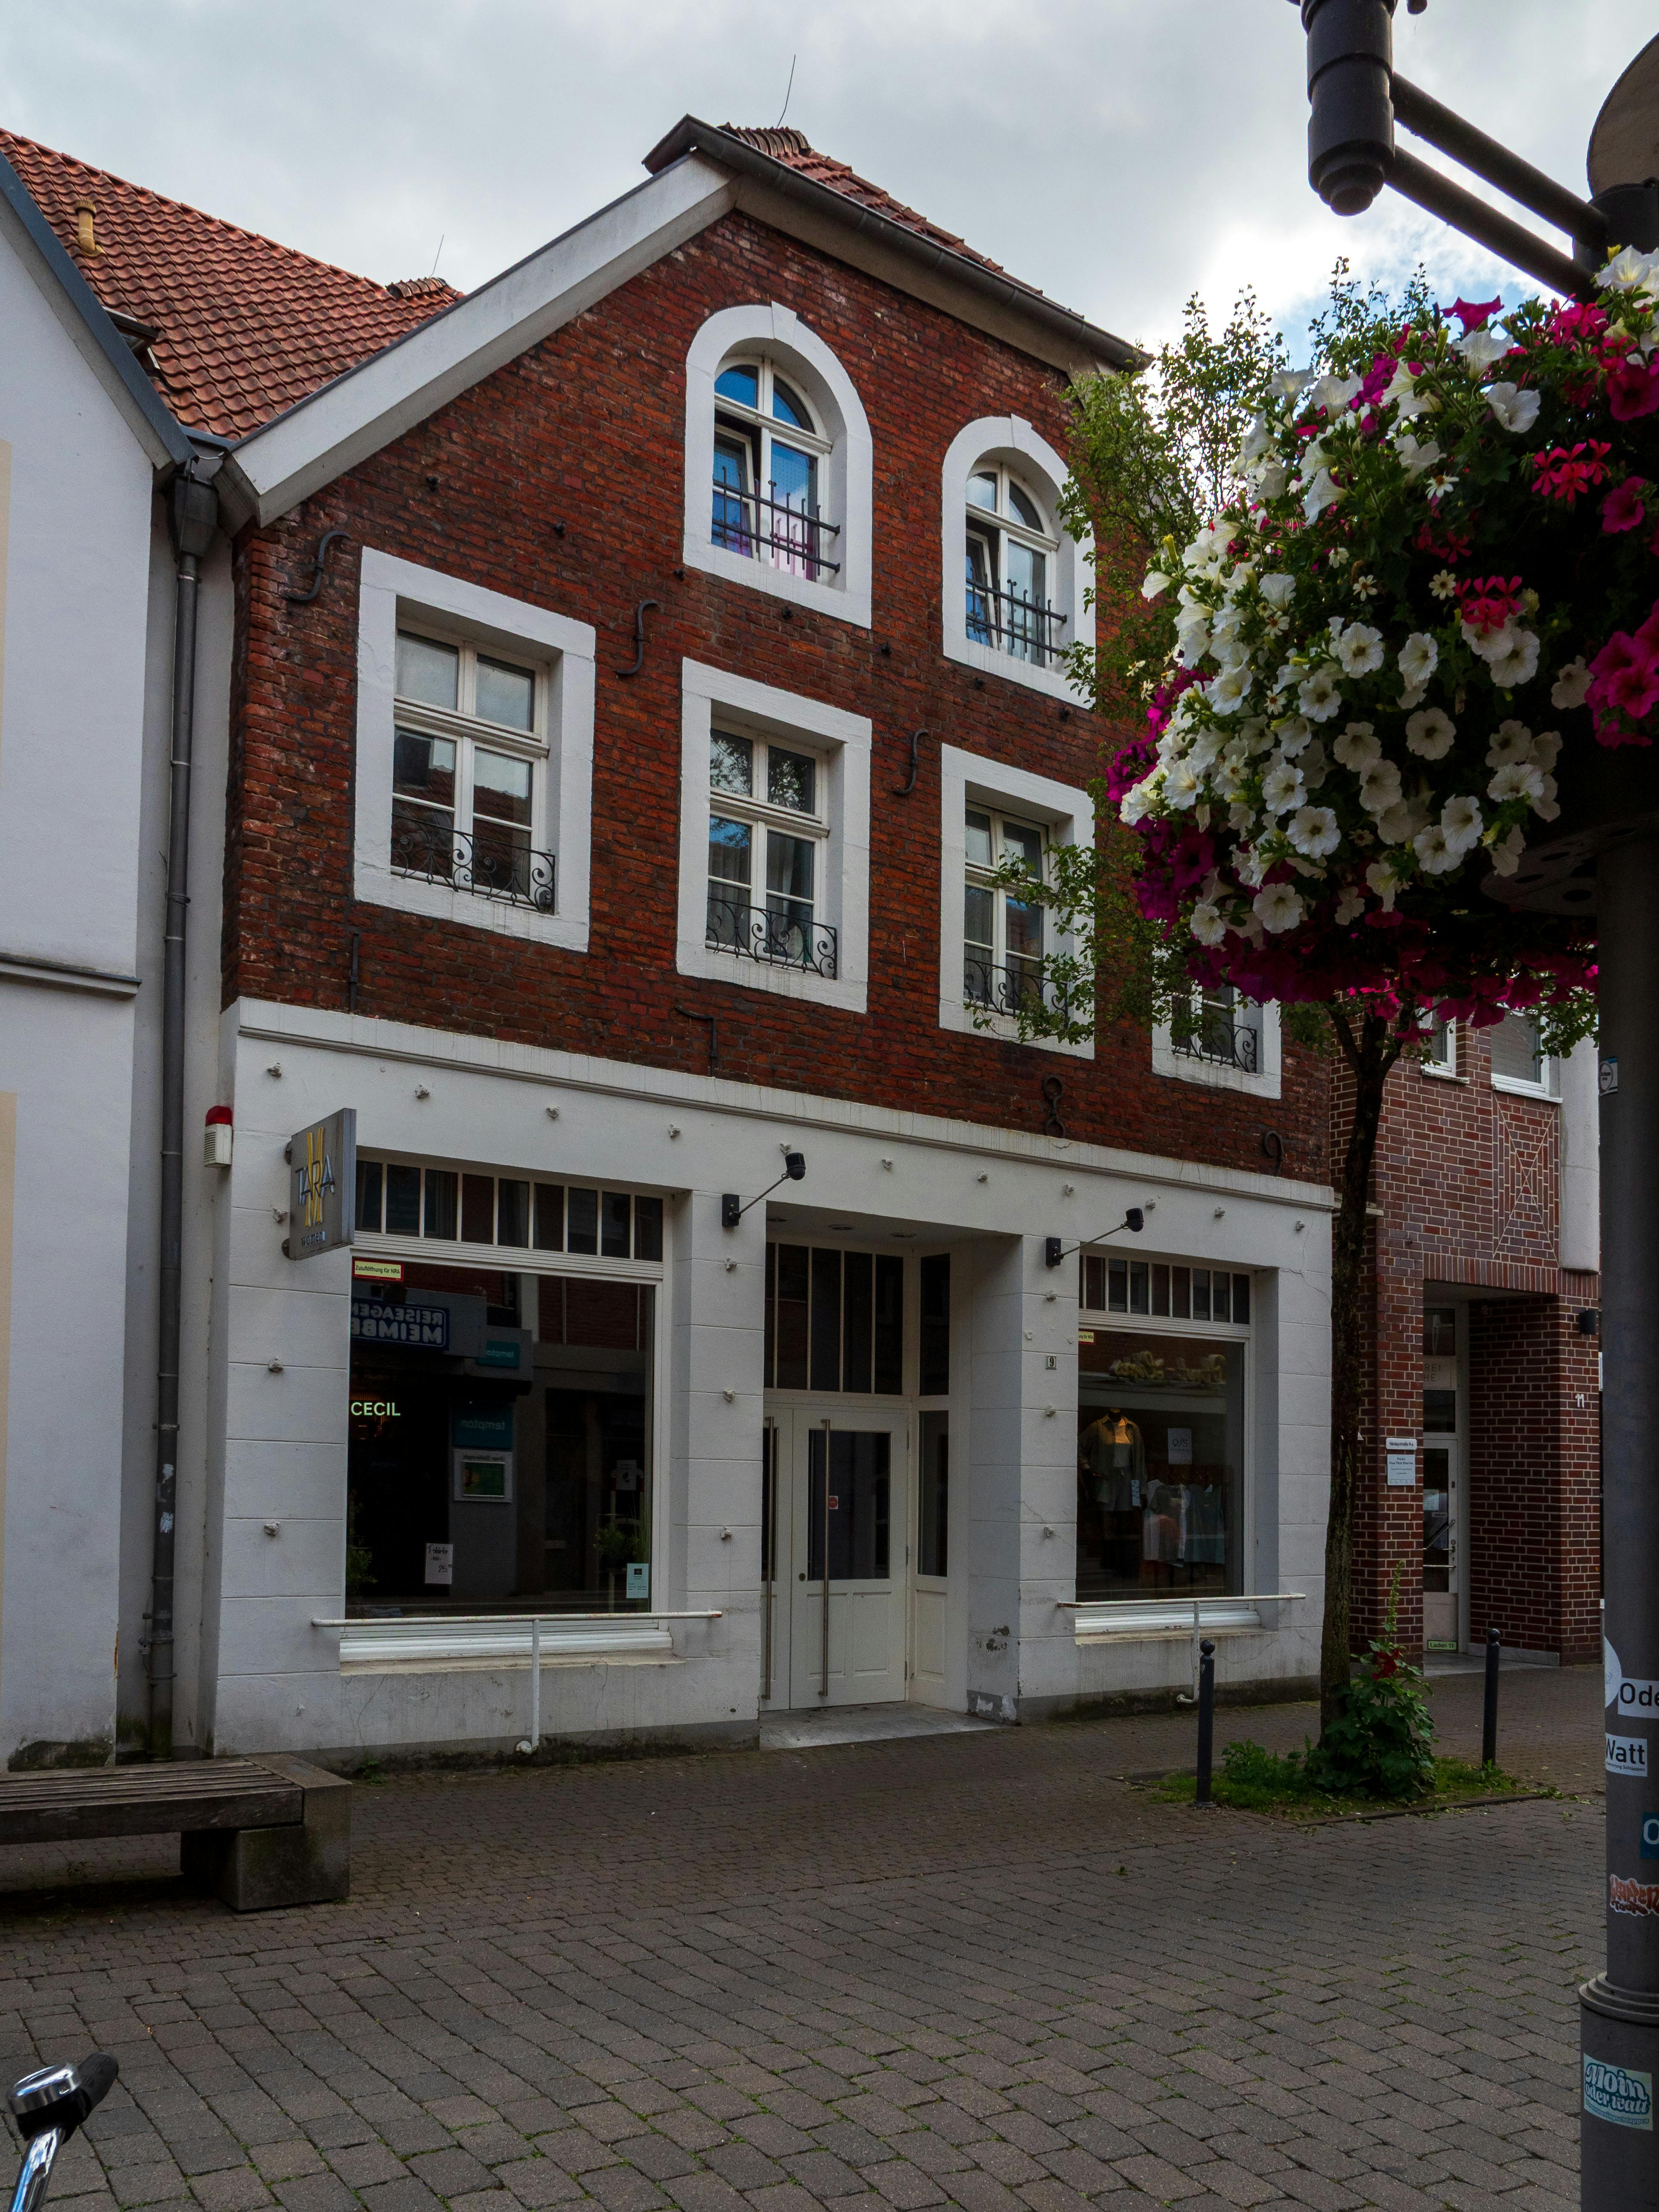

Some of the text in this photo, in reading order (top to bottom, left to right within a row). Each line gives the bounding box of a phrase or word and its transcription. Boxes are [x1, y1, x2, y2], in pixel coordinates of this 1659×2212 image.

[295, 1154, 335, 1206] TARA
[301, 1231, 326, 1247] women
[1050, 1356, 1054, 1368] 9
[1575, 1393, 1584, 1408] 11
[351, 1402, 401, 1416] CECIL
[1585, 2064, 1648, 2100] Moin
